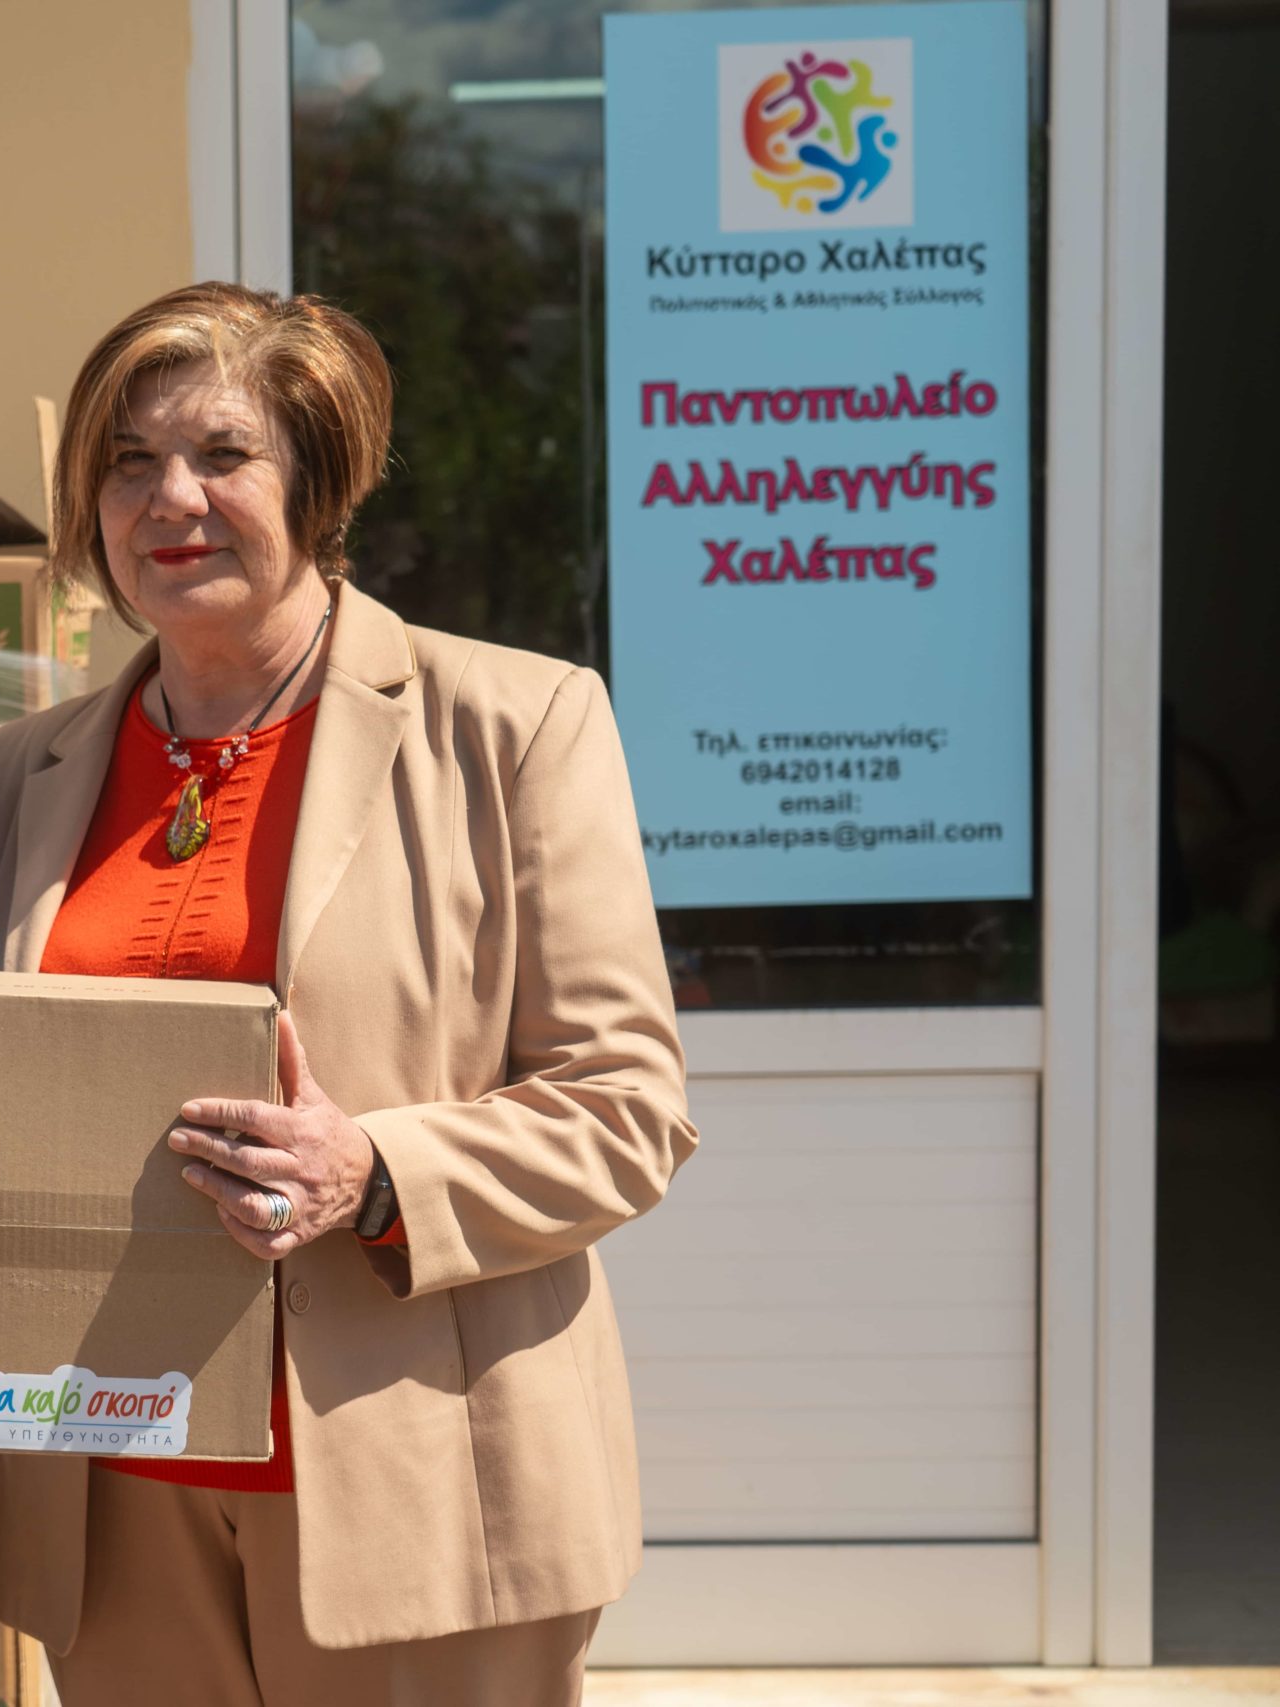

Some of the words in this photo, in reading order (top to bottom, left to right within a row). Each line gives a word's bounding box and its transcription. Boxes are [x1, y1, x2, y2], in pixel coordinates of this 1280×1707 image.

[646, 245, 806, 281] Κύτταρο
[818, 238, 987, 274] Χαλέπας
[640, 369, 998, 427] Παντοπωλείο
[641, 450, 997, 514] Αλληλεγγύης
[700, 535, 937, 592] Χαλέπας
[692, 729, 748, 758] Τηλ.
[758, 724, 948, 755] επικοινωνίας:
[740, 757, 901, 785] 6942014128
[778, 790, 862, 816] email:
[640, 820, 1003, 857] kytaroxalepas@gmail.com
[22, 1380, 81, 1424] καλό
[86, 1384, 177, 1421] σκοπό
[9, 1428, 174, 1447] ΥΠΕΥΘΥΝΟΤΗΤΑ
